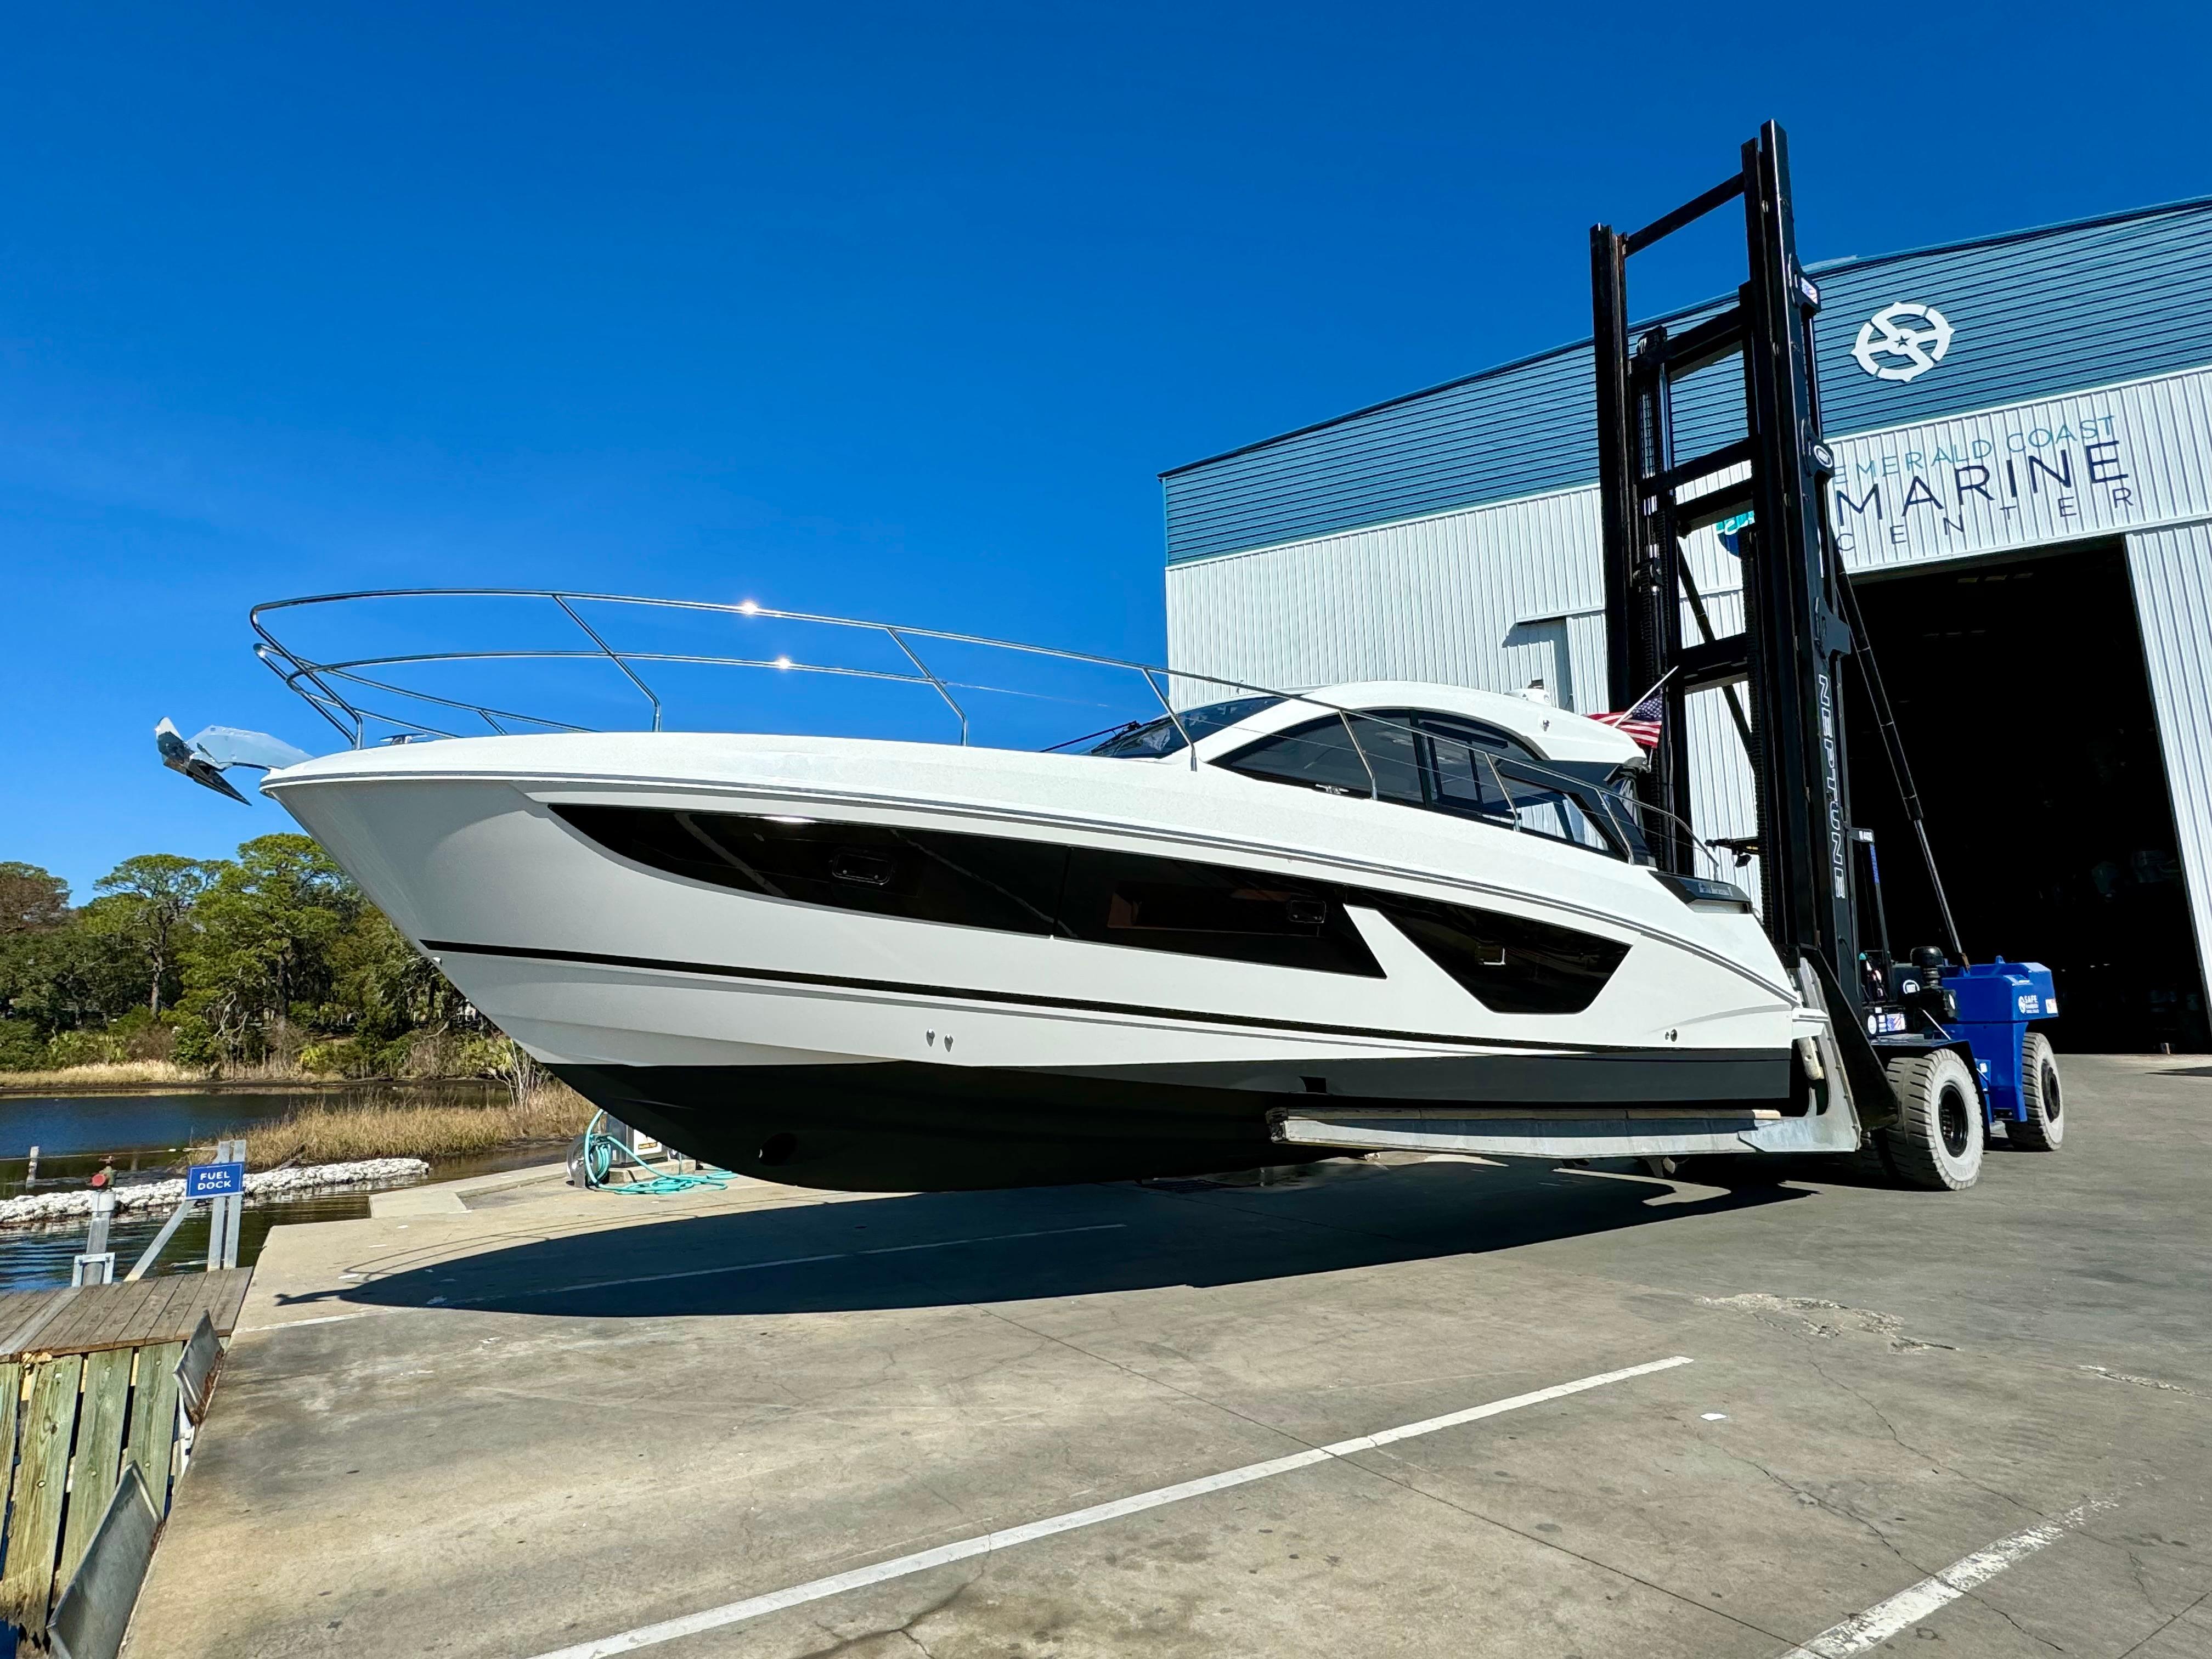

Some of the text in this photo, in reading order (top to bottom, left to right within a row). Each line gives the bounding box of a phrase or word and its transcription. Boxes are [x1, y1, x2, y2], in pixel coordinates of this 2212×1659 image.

[1834, 415, 2114, 484] EMERALD COAST
[1837, 441, 2129, 527] MARINE
[1838, 487, 2134, 551] CENTER
[1818, 674, 1846, 899] NEPTUNE
[2024, 995, 2038, 1003] SAFE
[198, 1180, 232, 1190] DOCK
[200, 1171, 230, 1181] FUEL
